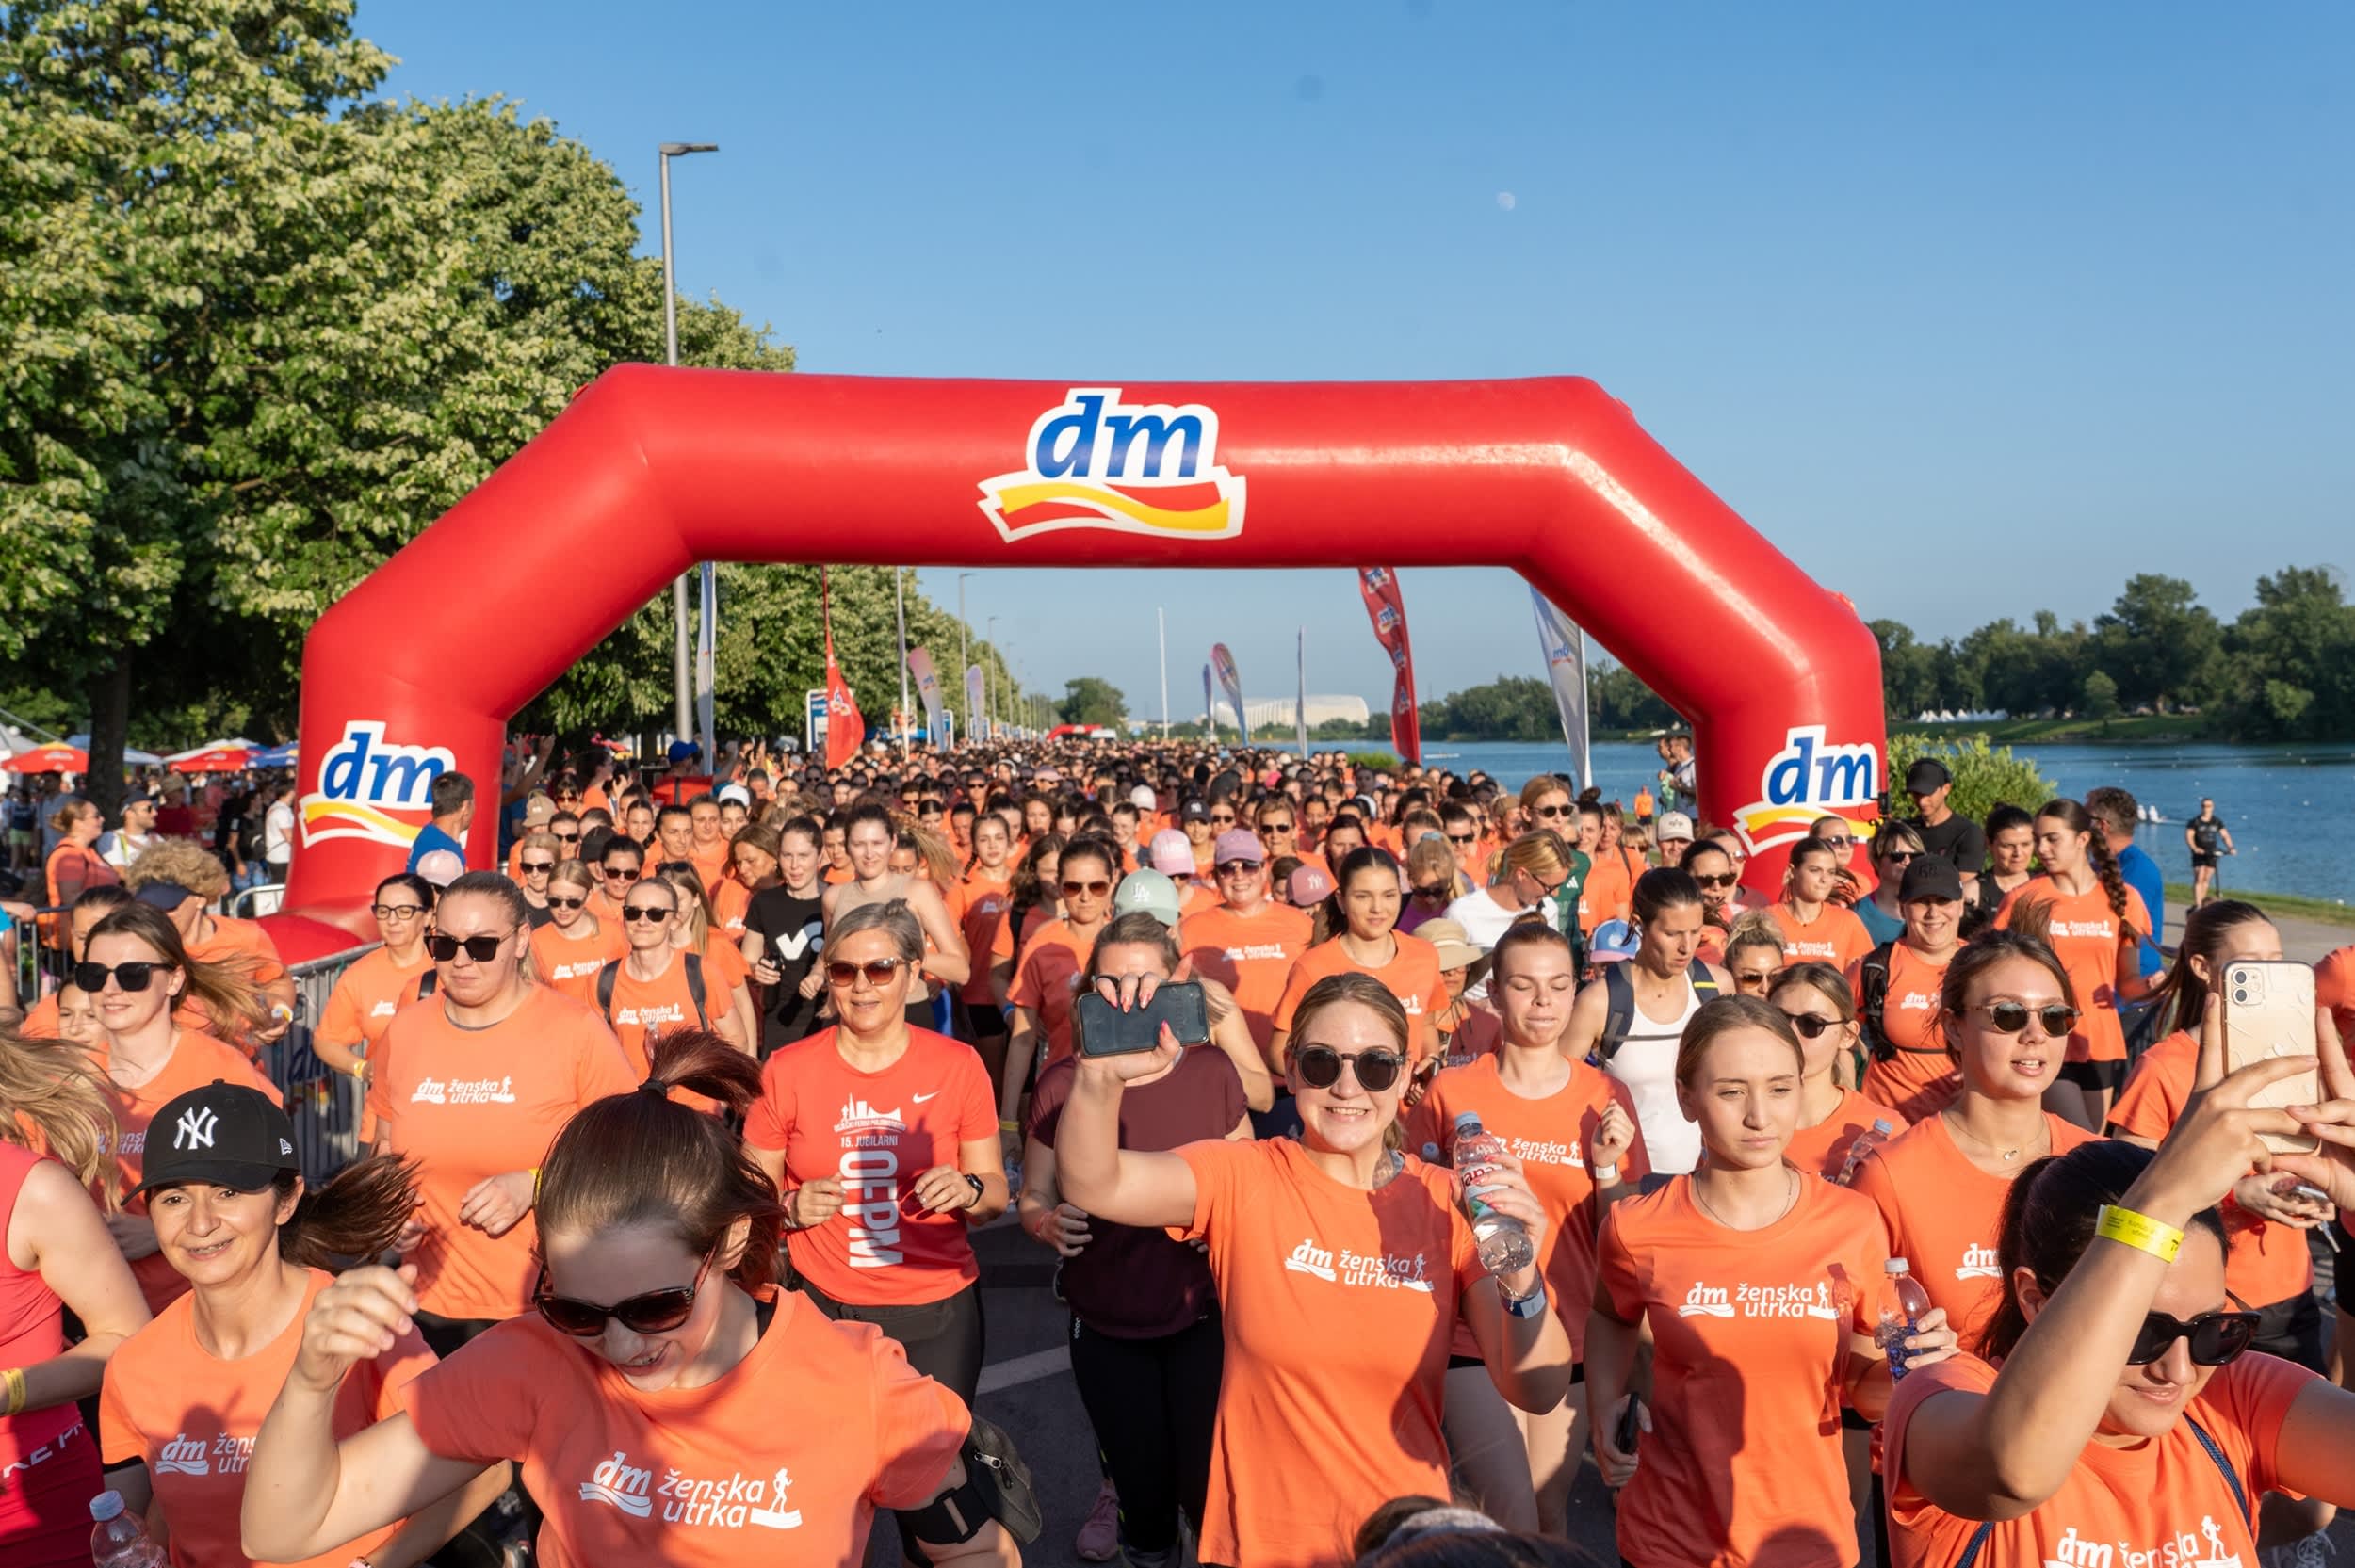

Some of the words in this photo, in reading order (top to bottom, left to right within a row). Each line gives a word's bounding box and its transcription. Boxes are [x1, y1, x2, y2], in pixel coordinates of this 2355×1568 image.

[1035, 395, 1203, 478] dm
[323, 732, 446, 804] dm
[1767, 736, 1873, 806] dm
[1133, 882, 1151, 903] LA
[417, 1076, 446, 1095] dm
[447, 1078, 499, 1094] ženska
[450, 1091, 491, 1104] utrka
[172, 1105, 219, 1151] NY
[840, 1136, 853, 1149] 15.
[855, 1135, 899, 1148] JUBILARNI
[1511, 1137, 1567, 1156] ženska
[1515, 1149, 1560, 1165] utrka
[839, 1150, 904, 1268] OFPM
[1291, 1237, 1334, 1269] dm
[1338, 1249, 1411, 1274] ženska
[1343, 1269, 1400, 1289] utrka
[1686, 1281, 1728, 1305] dm
[1735, 1282, 1813, 1303] ženska
[1744, 1300, 1805, 1318] utrka
[161, 1432, 207, 1461] dm
[212, 1431, 257, 1455] žens
[218, 1457, 250, 1474] utr
[593, 1450, 653, 1495] dm
[658, 1468, 766, 1503] ženska
[662, 1496, 748, 1528] utrka
[2057, 1527, 2113, 1568] dm
